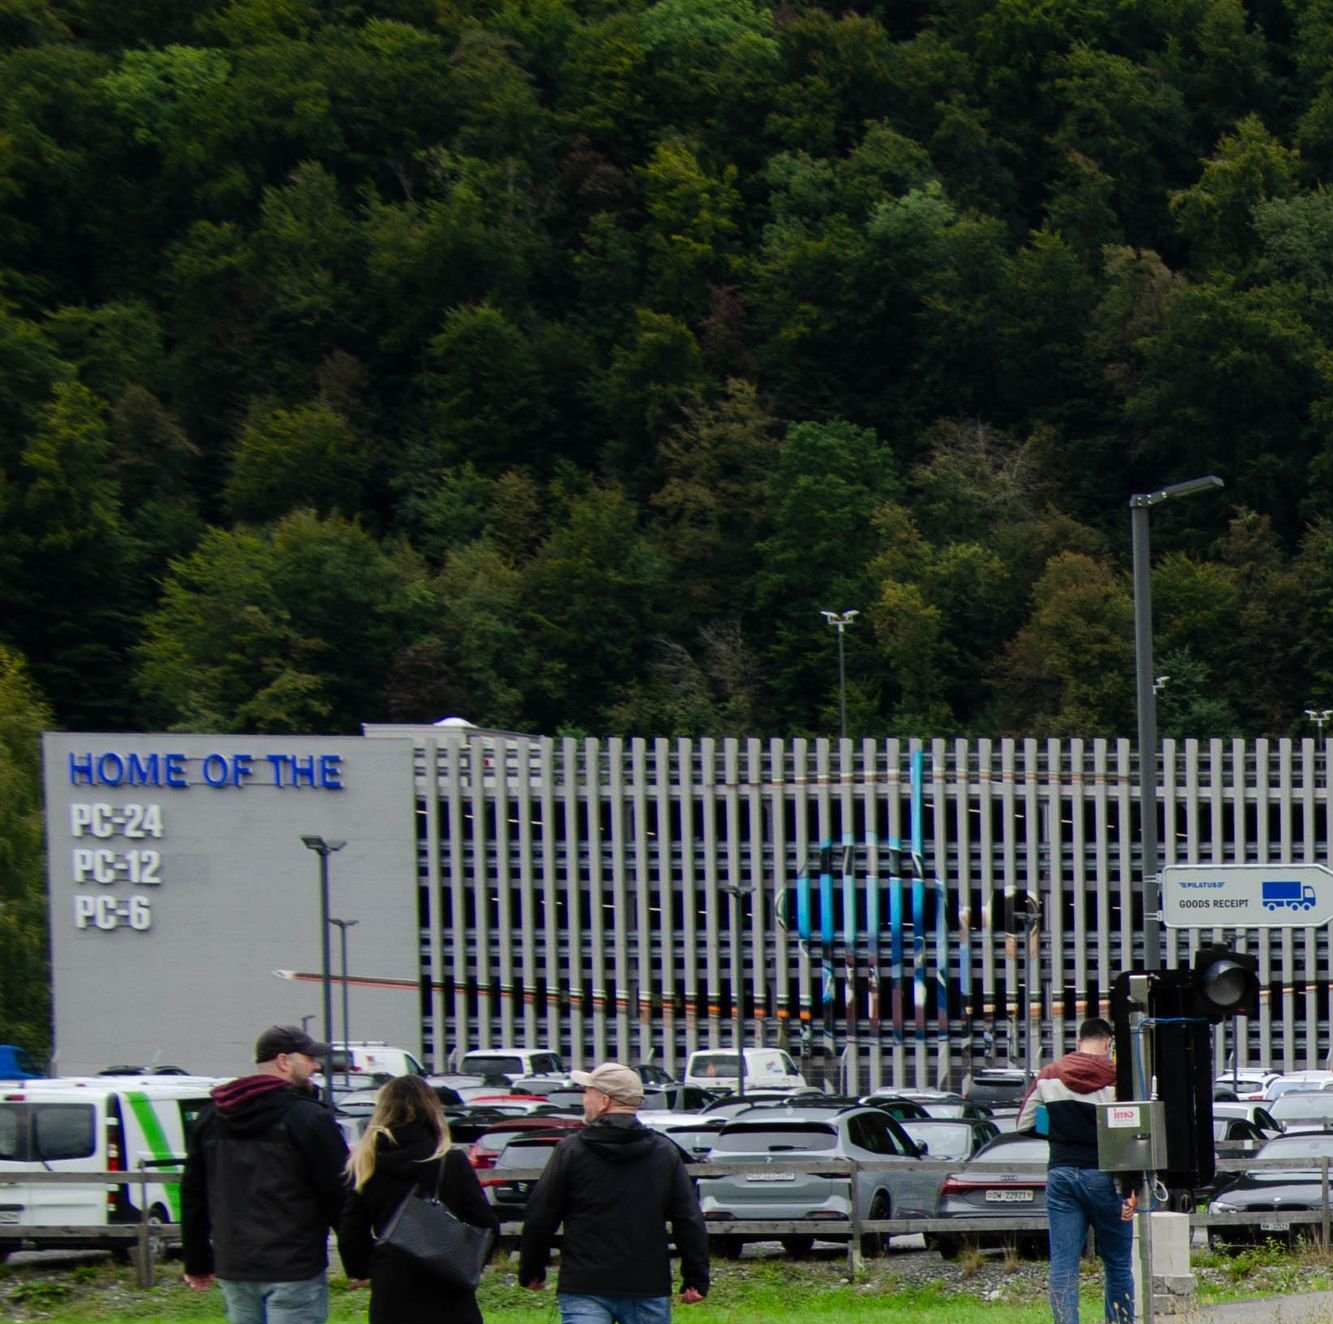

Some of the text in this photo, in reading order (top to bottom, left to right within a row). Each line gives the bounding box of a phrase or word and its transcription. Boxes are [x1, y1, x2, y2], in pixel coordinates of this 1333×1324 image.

[69, 752, 344, 789] HOME OF THE
[70, 803, 163, 838] PC-24
[73, 849, 161, 884] PC-12
[74, 895, 151, 930] PC-6
[1179, 899, 1249, 908] GOODS RECEIPT
